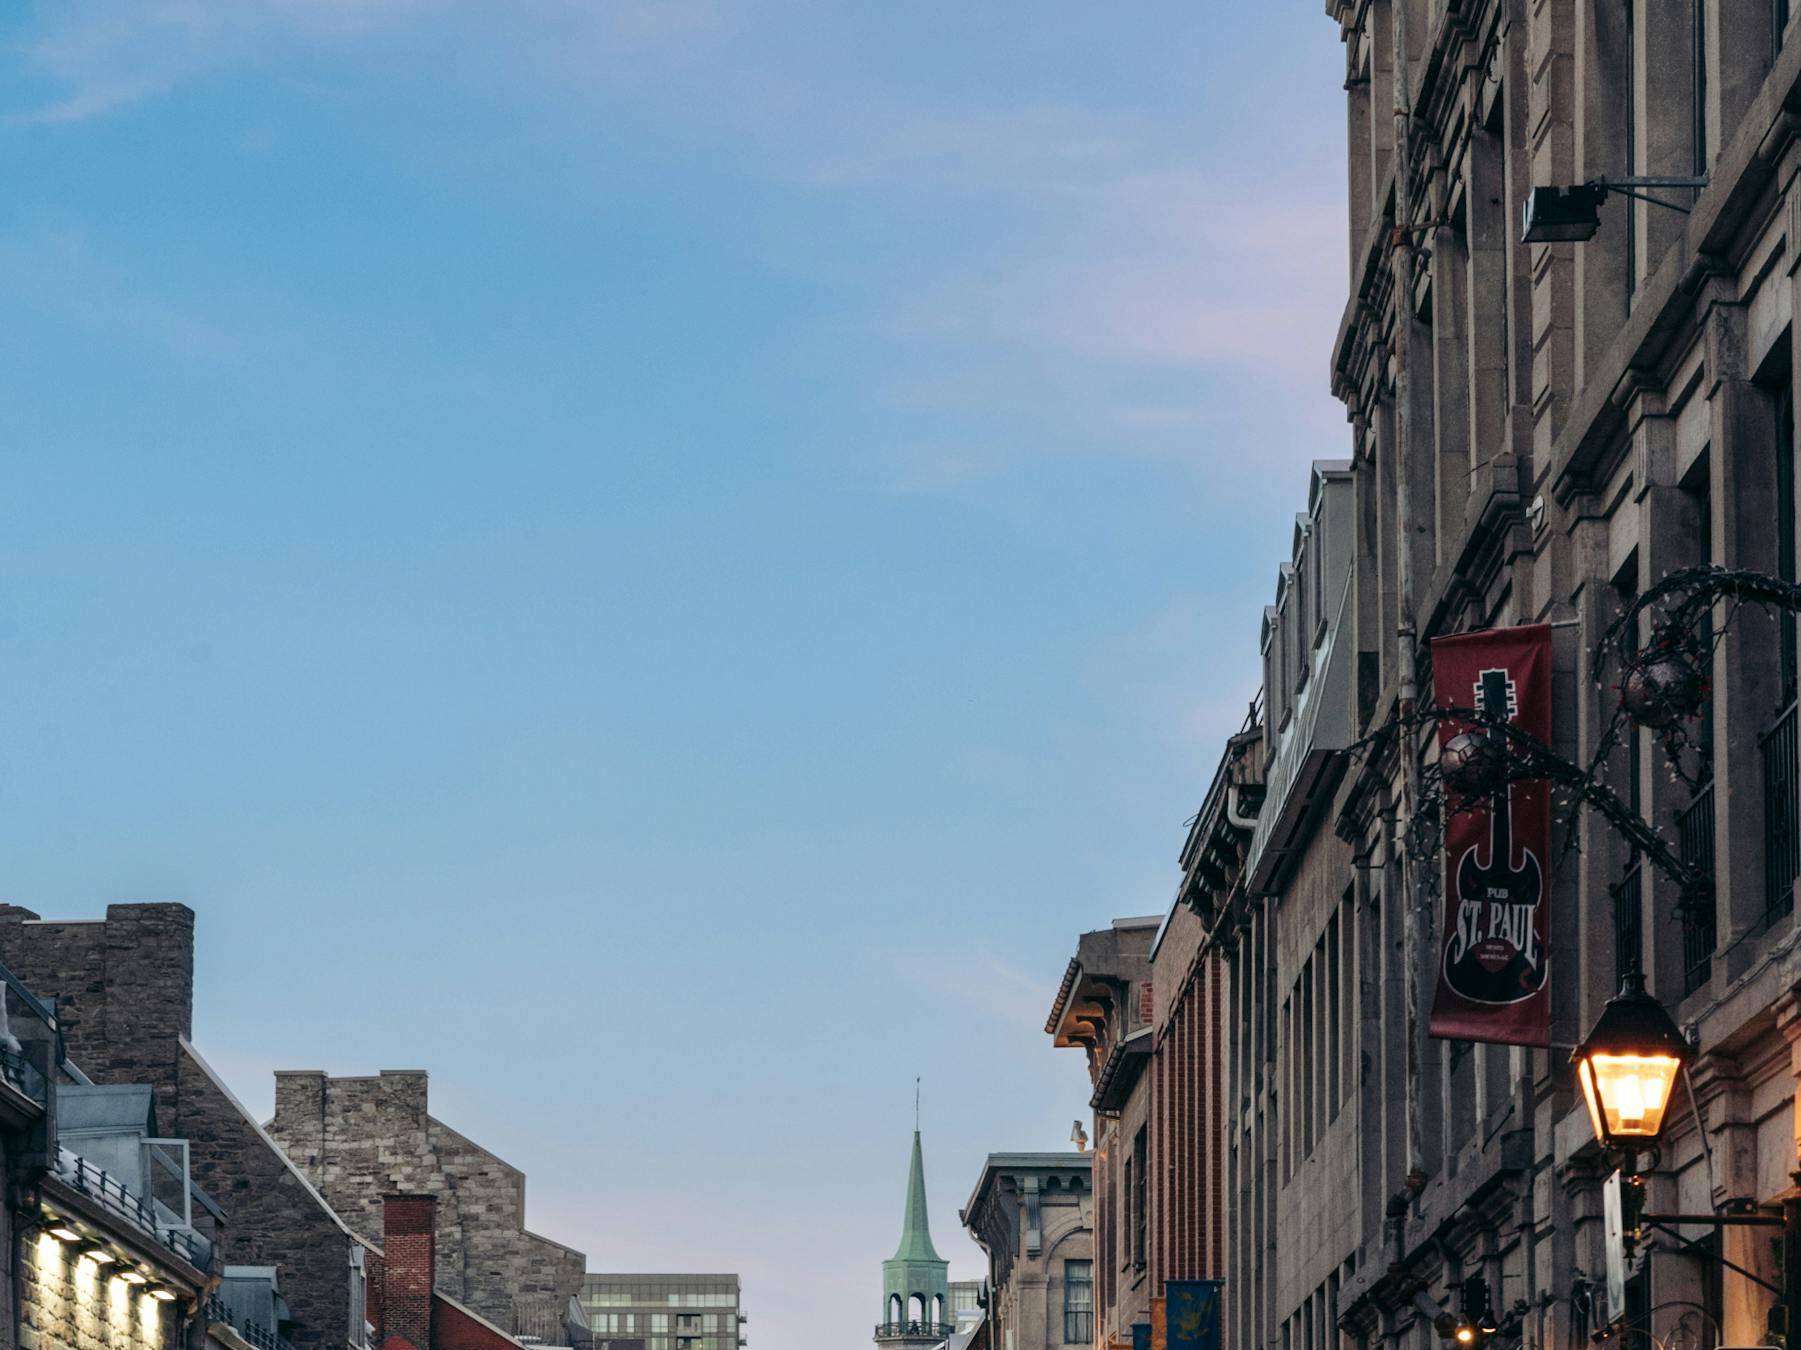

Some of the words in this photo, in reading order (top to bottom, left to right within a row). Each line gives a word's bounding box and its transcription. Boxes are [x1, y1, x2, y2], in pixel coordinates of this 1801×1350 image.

[1487, 887, 1509, 899] PUB
[1453, 898, 1482, 965] ST.
[1487, 902, 1538, 971] PAUL
